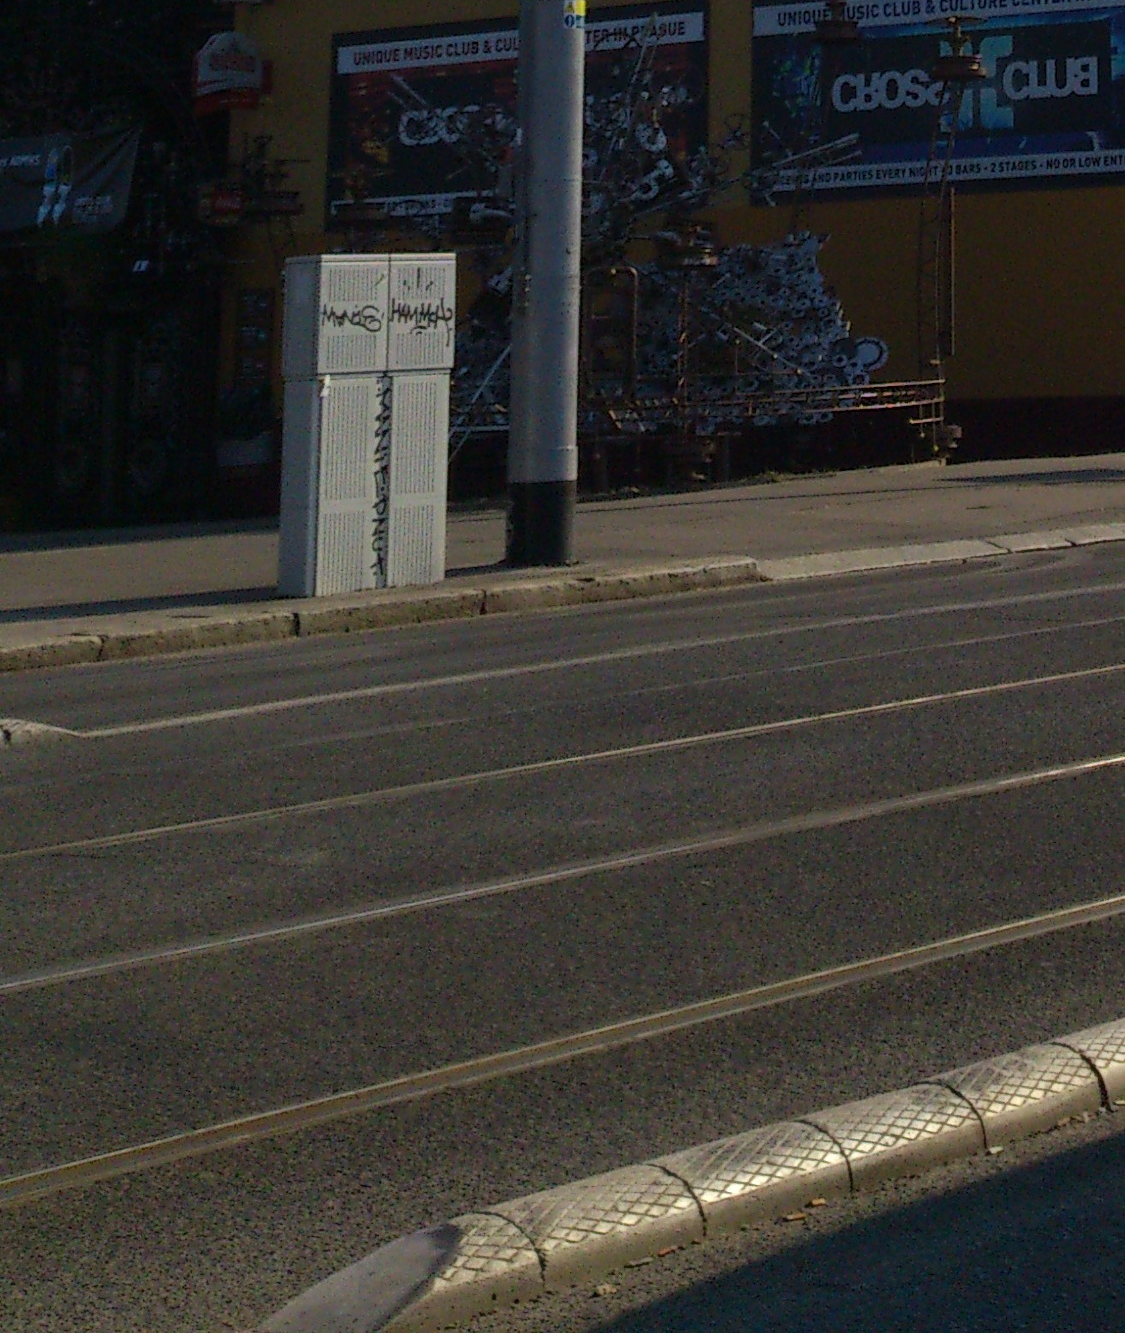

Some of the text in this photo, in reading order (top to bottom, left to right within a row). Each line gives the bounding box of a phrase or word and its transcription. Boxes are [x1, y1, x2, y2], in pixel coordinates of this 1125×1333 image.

[841, 3, 879, 21] USIC
[883, 0, 921, 18] CLUB
[925, 0, 935, 14] &
[353, 48, 400, 66] UNIQUE
[403, 44, 443, 61] MUSIC
[446, 41, 479, 57] CLUB
[1002, 55, 1099, 101] CLUB
[833, 168, 873, 183] PARTIES
[875, 167, 906, 180] EVERY
[1079, 156, 1101, 168] LOW
